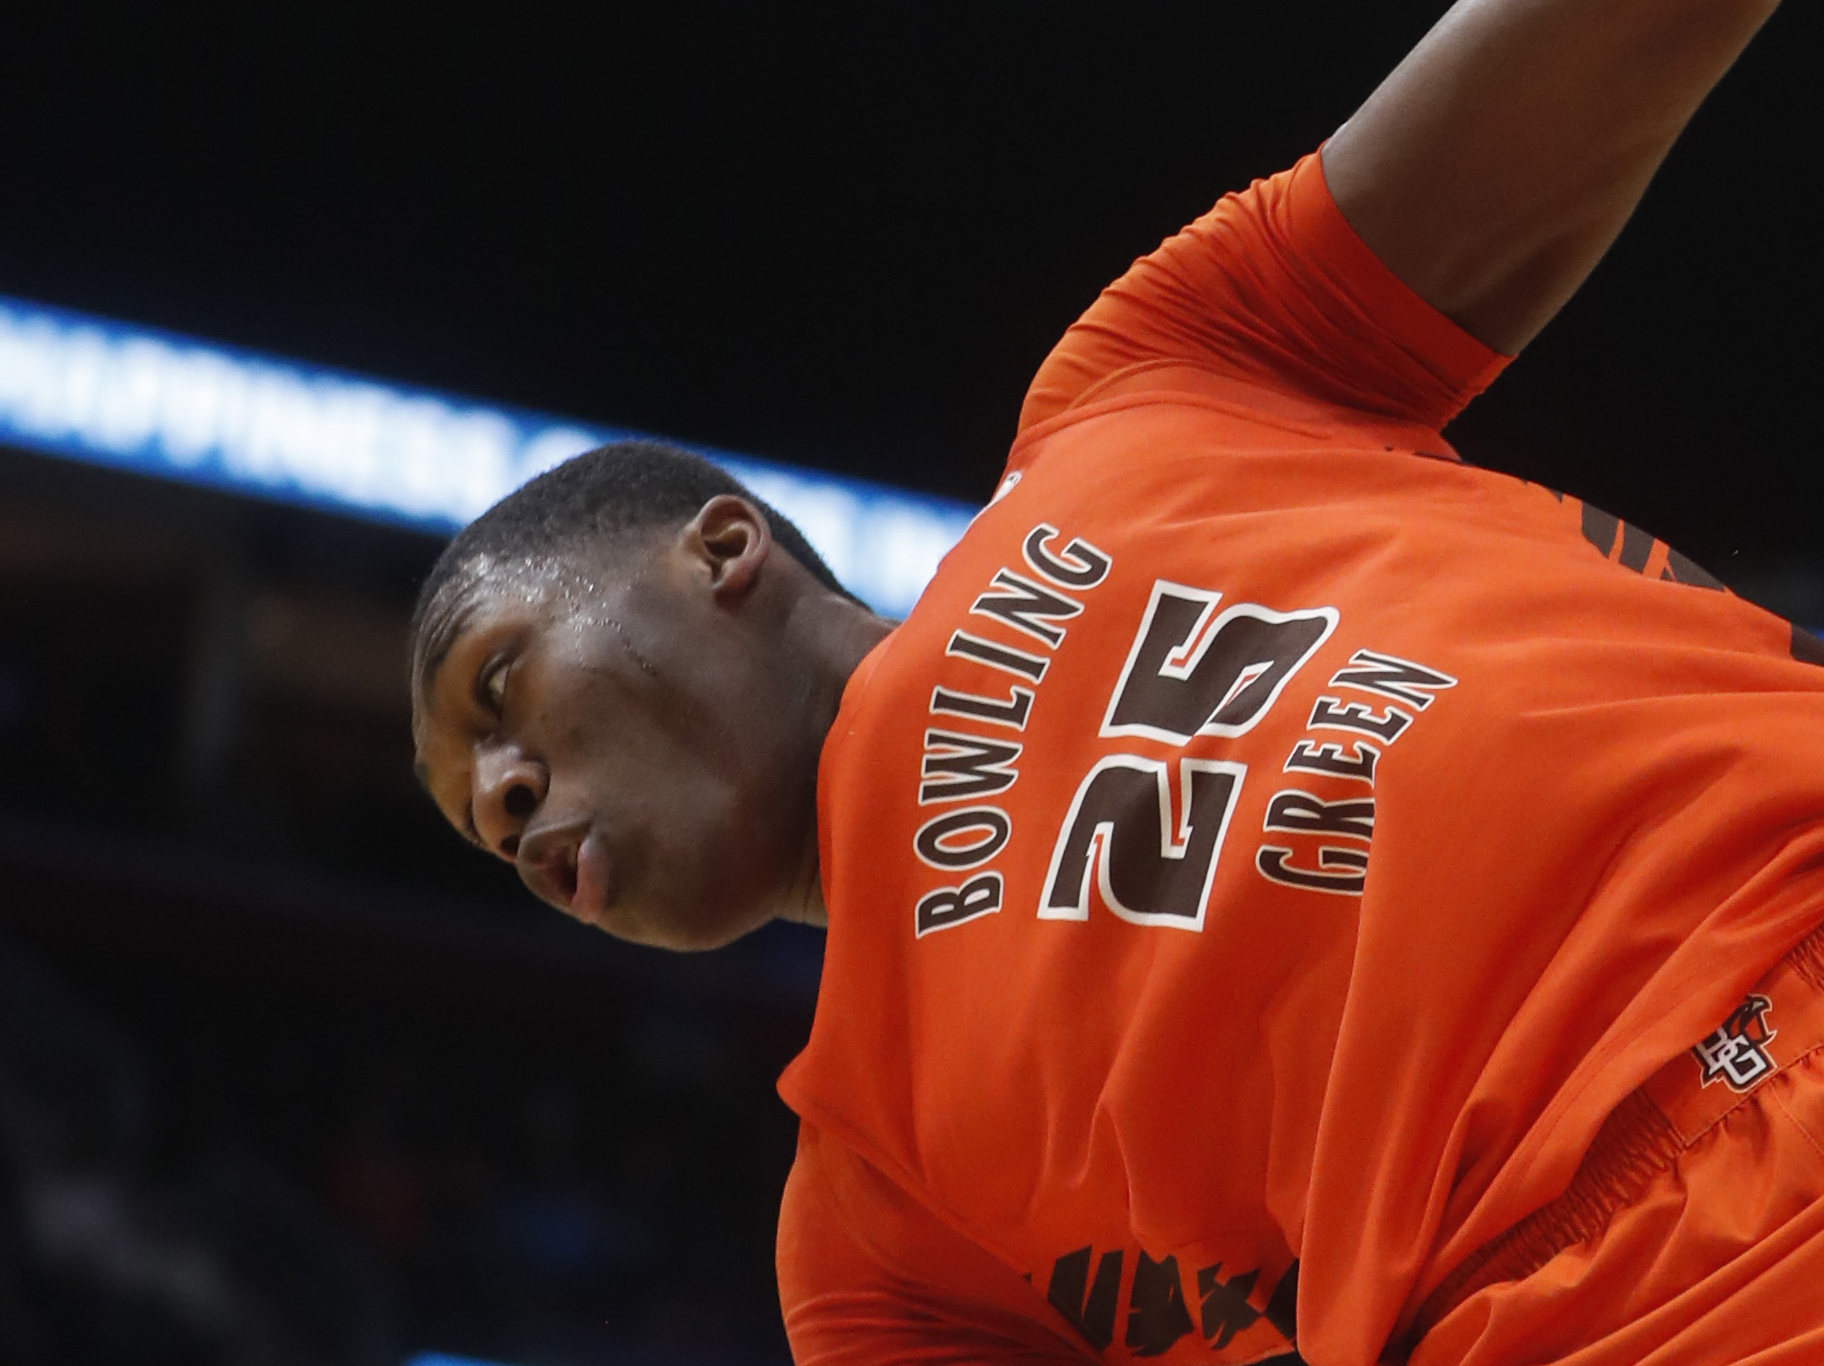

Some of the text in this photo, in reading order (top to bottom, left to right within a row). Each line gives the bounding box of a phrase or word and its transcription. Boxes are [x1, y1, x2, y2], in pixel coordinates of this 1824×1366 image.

[913, 521, 1112, 939] BOWLING
[1037, 578, 1340, 933] 25
[1256, 648, 1458, 897] GREEN
